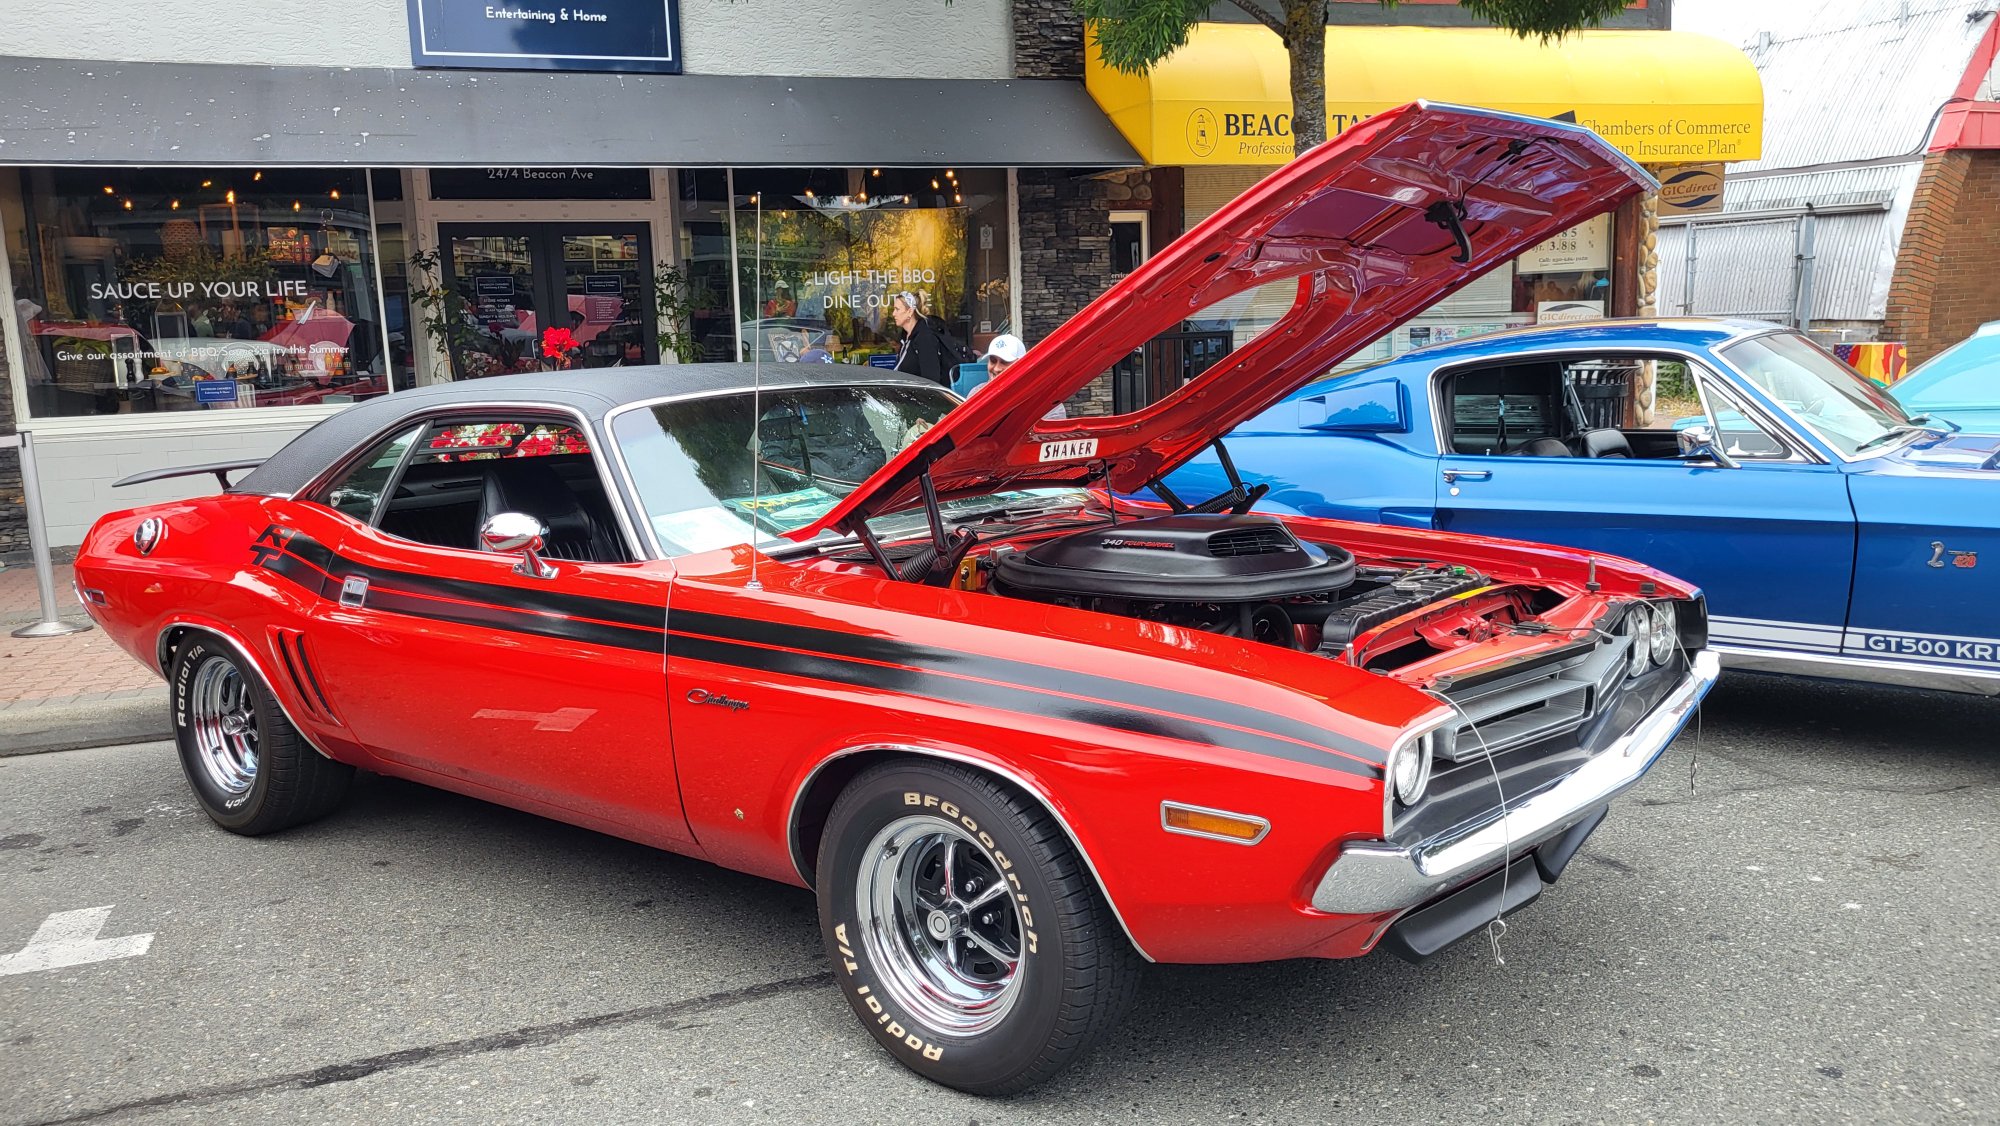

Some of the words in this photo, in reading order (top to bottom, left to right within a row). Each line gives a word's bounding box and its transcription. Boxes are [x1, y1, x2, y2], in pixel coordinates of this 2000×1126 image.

[485, 6, 556, 24] Entertaining
[560, 8, 569, 21] &
[573, 9, 607, 22] Home
[1224, 113, 1295, 136] BEAC
[1658, 119, 1674, 135] of
[1675, 119, 1751, 136] Commerce
[1238, 141, 1296, 157] Professio
[1638, 140, 1703, 156] Insurance
[523, 168, 566, 179] Beacon
[571, 168, 594, 179] Ave
[1661, 182, 1718, 196] GICdirect
[814, 270, 862, 286] LIGHT
[867, 269, 898, 284] THE
[903, 269, 936, 284] BBQ
[91, 282, 162, 299] SAUCE
[168, 282, 195, 299] UP
[200, 281, 260, 298] YOUR
[266, 280, 308, 297] LIFE
[823, 294, 861, 309] DINE
[57, 351, 84, 361] Give
[109, 349, 171, 360] assortment
[175, 349, 187, 358] of
[191, 346, 217, 357] BBQ
[273, 345, 286, 357] try
[290, 344, 306, 354] this
[309, 344, 349, 355] Summer
[1044, 442, 1092, 459] SHAKER
[1101, 538, 1124, 547] 340
[1952, 555, 1977, 568] 428
[187, 644, 206, 664] T/A
[1868, 635, 1949, 657] GT500
[177, 661, 192, 727] Radial
[904, 791, 1038, 954] BFGoodrich
[834, 923, 859, 976] T/A
[857, 985, 944, 1062] Radial
